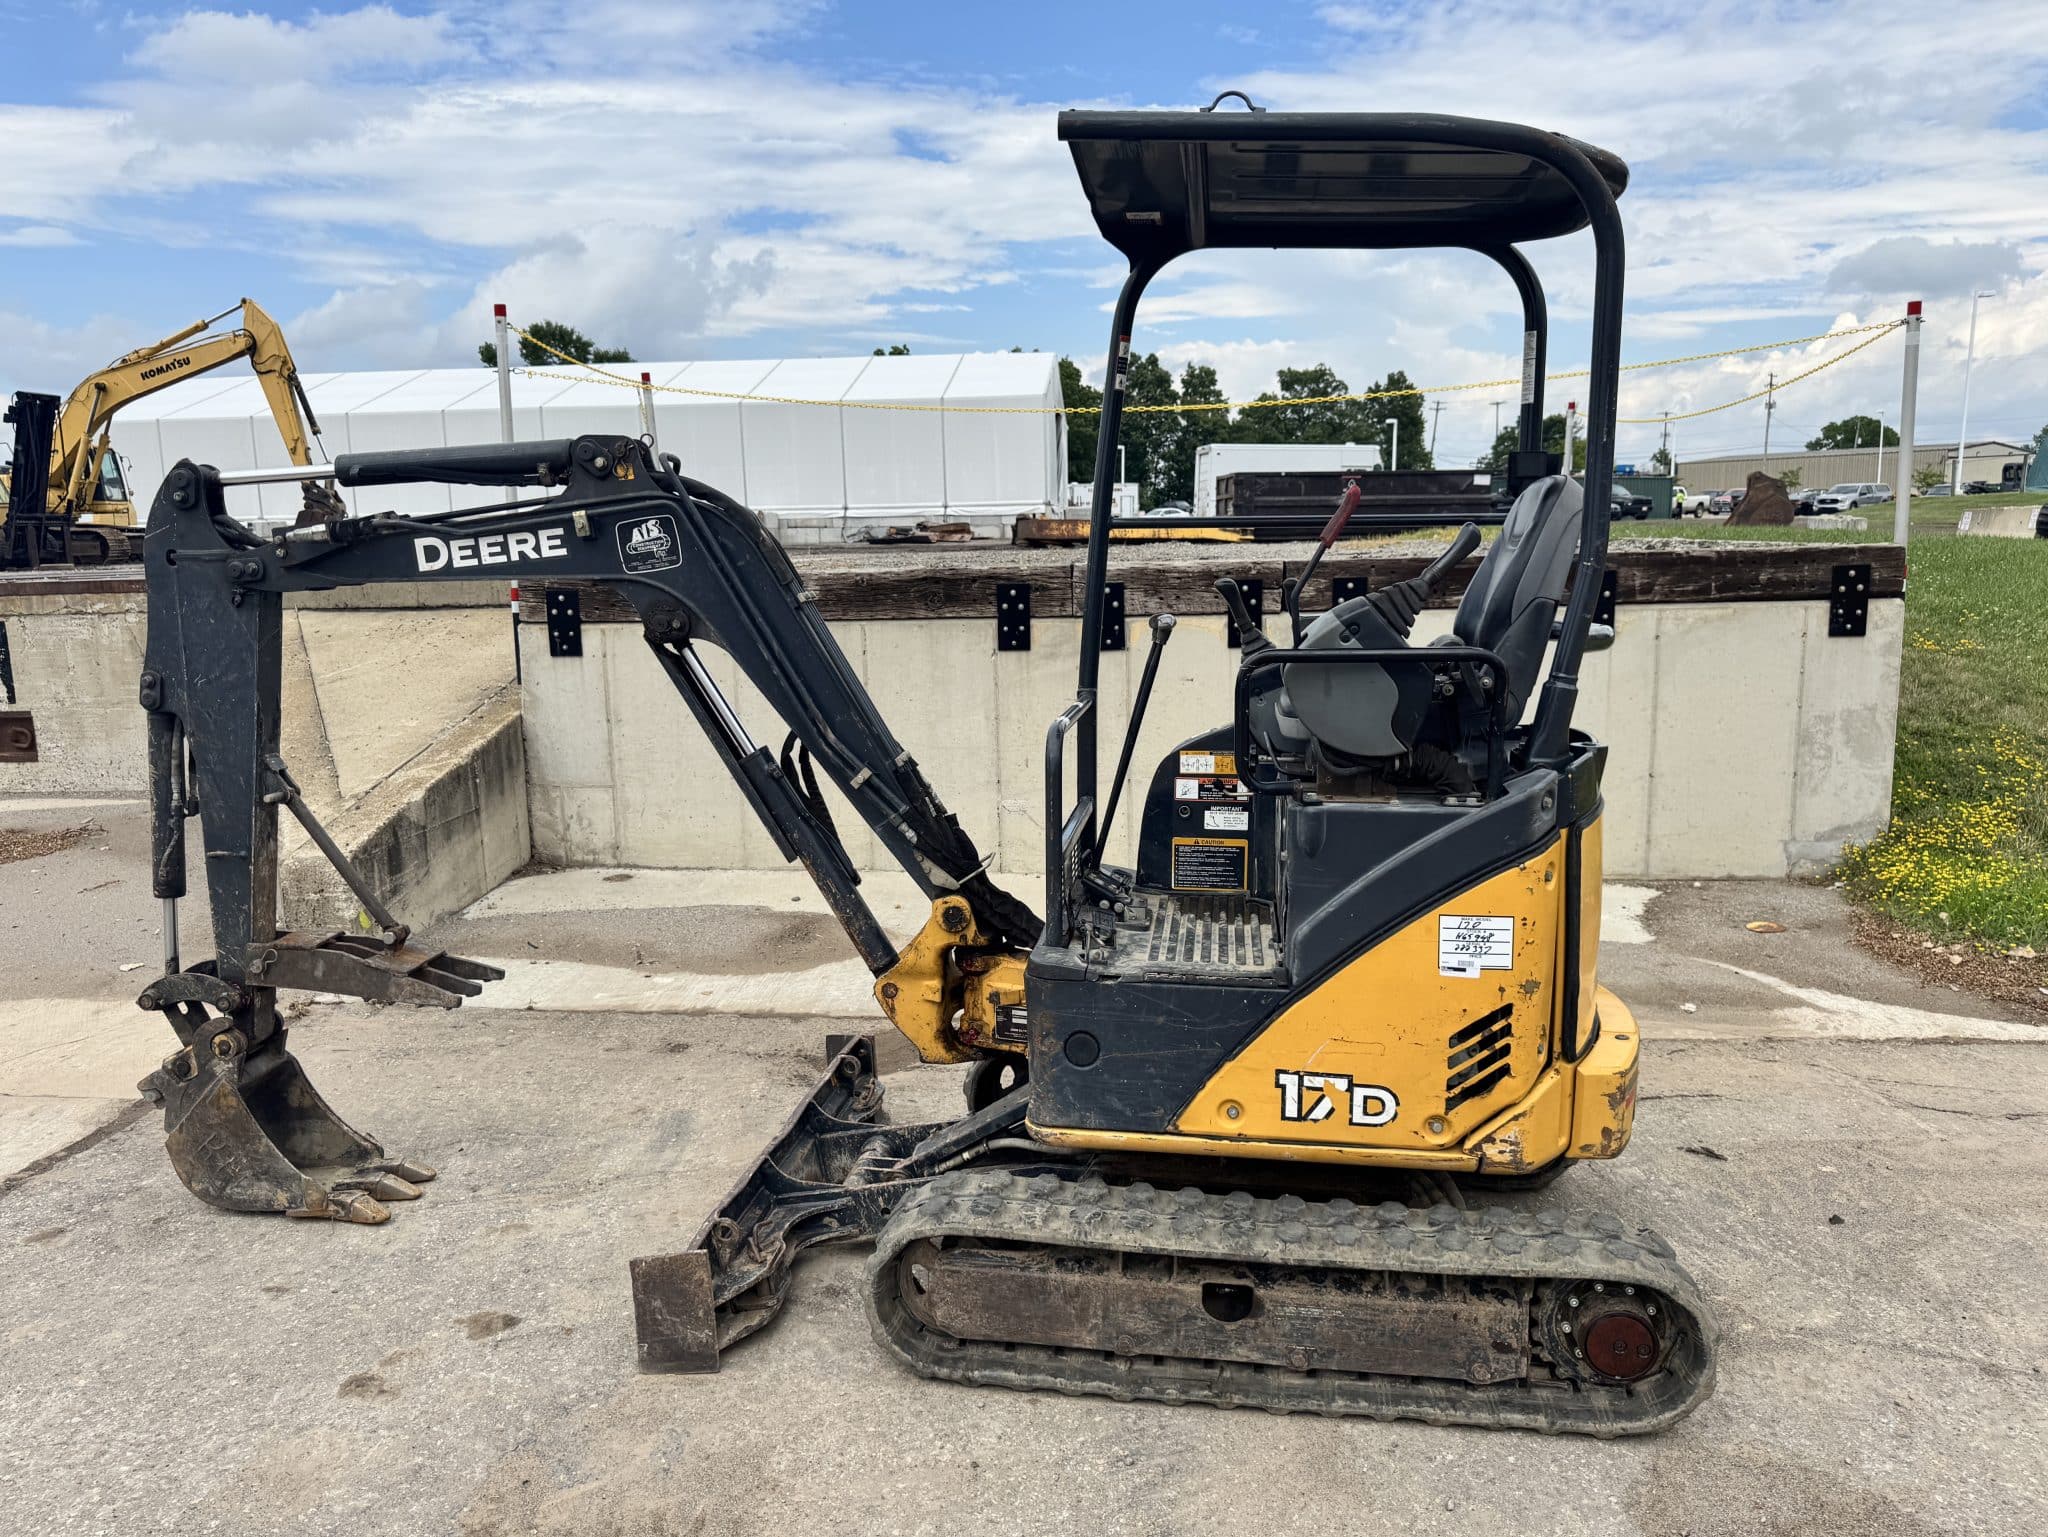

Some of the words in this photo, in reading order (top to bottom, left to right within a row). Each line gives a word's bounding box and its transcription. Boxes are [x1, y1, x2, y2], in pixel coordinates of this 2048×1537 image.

[140, 356, 191, 381] KOMATSU
[413, 527, 568, 573] DEERE
[1275, 1068, 1400, 1128] 17D
